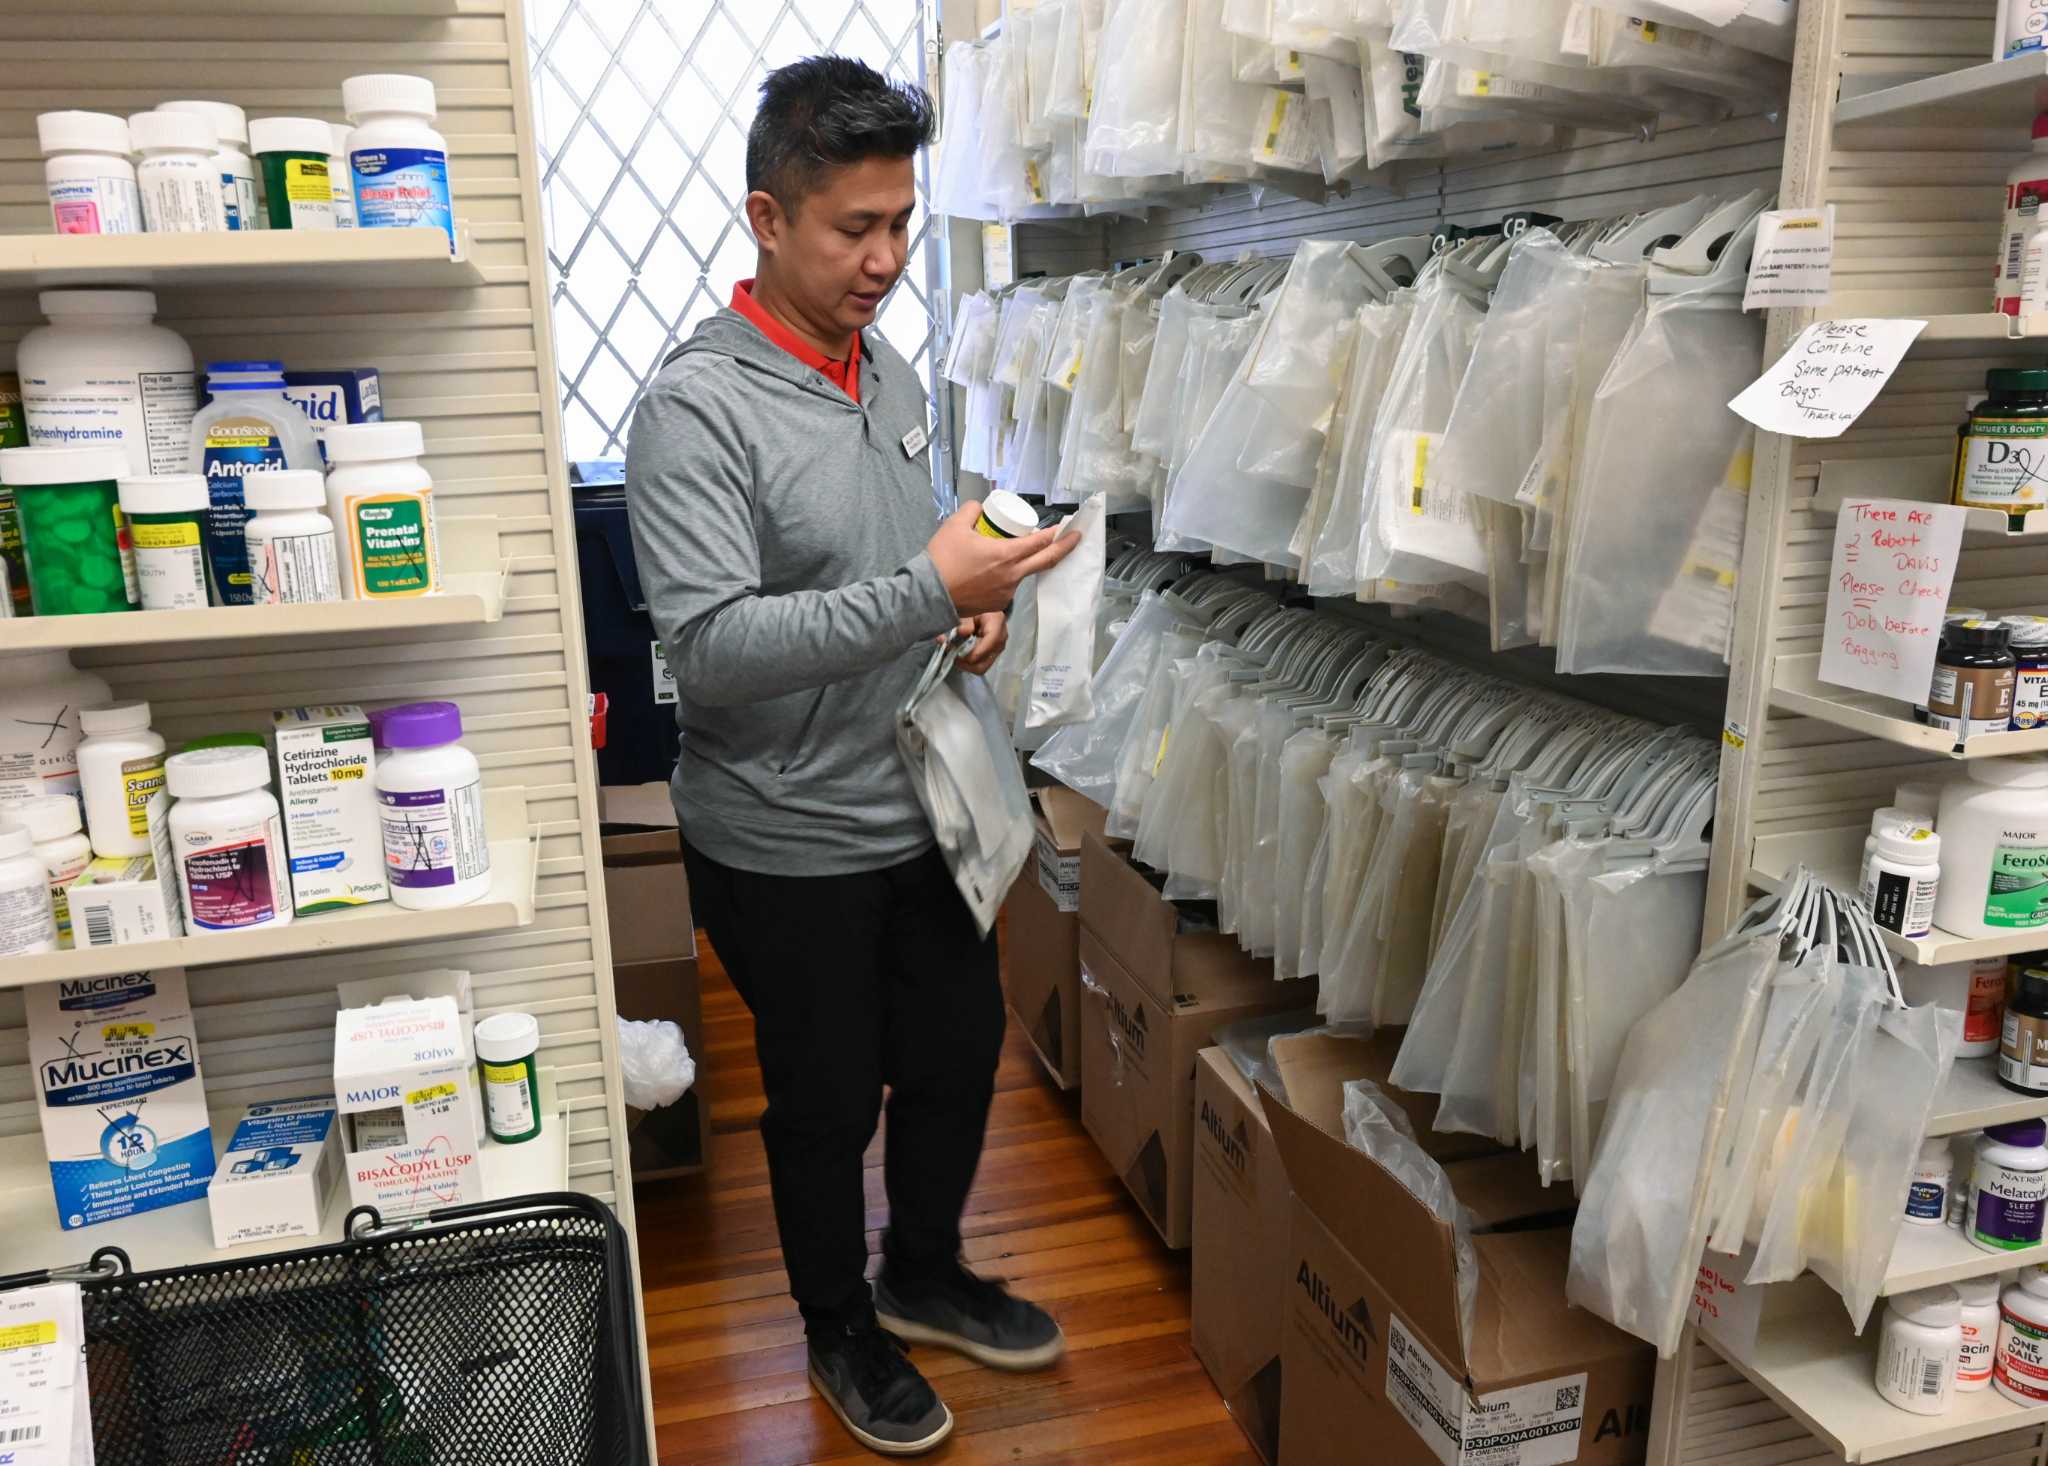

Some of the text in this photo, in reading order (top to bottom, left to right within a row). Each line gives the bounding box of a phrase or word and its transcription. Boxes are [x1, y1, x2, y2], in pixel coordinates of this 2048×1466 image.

[51, 186, 93, 197] NOPHEN
[1807, 339, 1874, 356] Combine
[143, 375, 157, 384] Drug
[159, 374, 173, 383] Facts
[2009, 424, 2046, 434] BOUNTY
[211, 437, 267, 447] Regular Strength
[1987, 441, 2020, 465] D3
[207, 458, 283, 478] Antacid
[1848, 503, 1897, 523] There
[365, 523, 418, 538] Prenatal
[365, 535, 421, 550] Vitamins
[1892, 552, 1941, 573] Davis
[2016, 700, 2039, 709] 45 mg
[282, 747, 339, 762] Cetirizine
[285, 754, 368, 774] Hydrochloride
[127, 774, 165, 792] Senna
[288, 768, 363, 786] Tablets 10 mg
[288, 785, 339, 798] Antihistamine
[289, 796, 318, 807] Allergy
[2002, 830, 2038, 840] MAJOR
[59, 970, 152, 998] Mucinex
[377, 1020, 446, 1039] BISACODYL
[413, 1047, 456, 1062] MAJOR
[47, 1044, 187, 1087] Mucinex
[101, 1096, 148, 1111] EXPECTORANT
[345, 1085, 401, 1105] MAJOR
[1200, 1100, 1246, 1172] Altium
[393, 1149, 412, 1160] Unit
[88, 1162, 192, 1191] Relieves Chest Congestion
[356, 1153, 473, 1183] BISACODYL USP
[90, 1171, 191, 1200] Thins and Loosens Mucus
[91, 1174, 213, 1209] Immediate and Extended Release
[373, 1176, 420, 1189] STIMULANT
[2008, 1201, 2036, 1211] SLEEP
[1296, 1258, 1368, 1362] Altium
[1961, 1343, 1990, 1355] acin
[2008, 1343, 2043, 1365] DAILY
[2011, 1336, 2040, 1354] ONE
